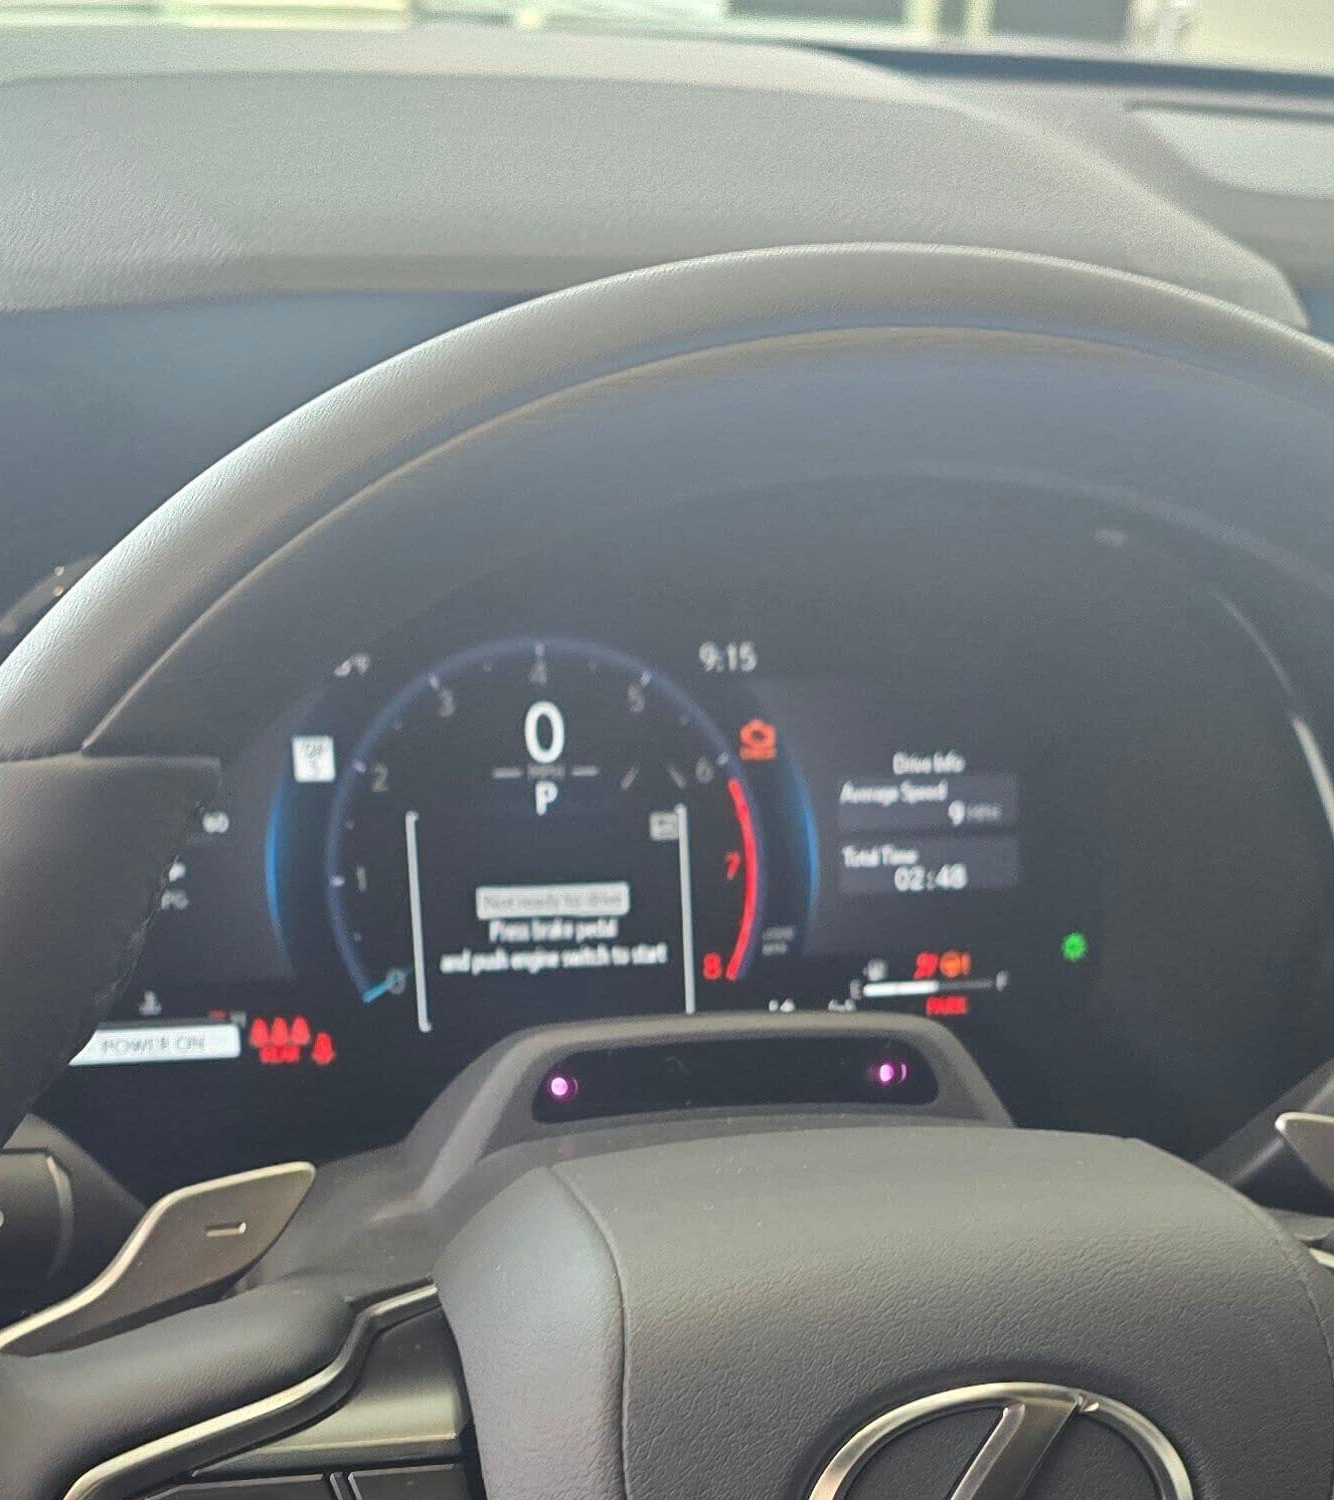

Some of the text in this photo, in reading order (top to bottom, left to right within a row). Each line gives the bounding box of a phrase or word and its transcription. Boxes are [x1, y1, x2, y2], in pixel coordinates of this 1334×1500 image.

[699, 642, 758, 672] 9:15
[525, 701, 565, 764] 0
[371, 764, 389, 792] 2
[534, 781, 559, 816] P
